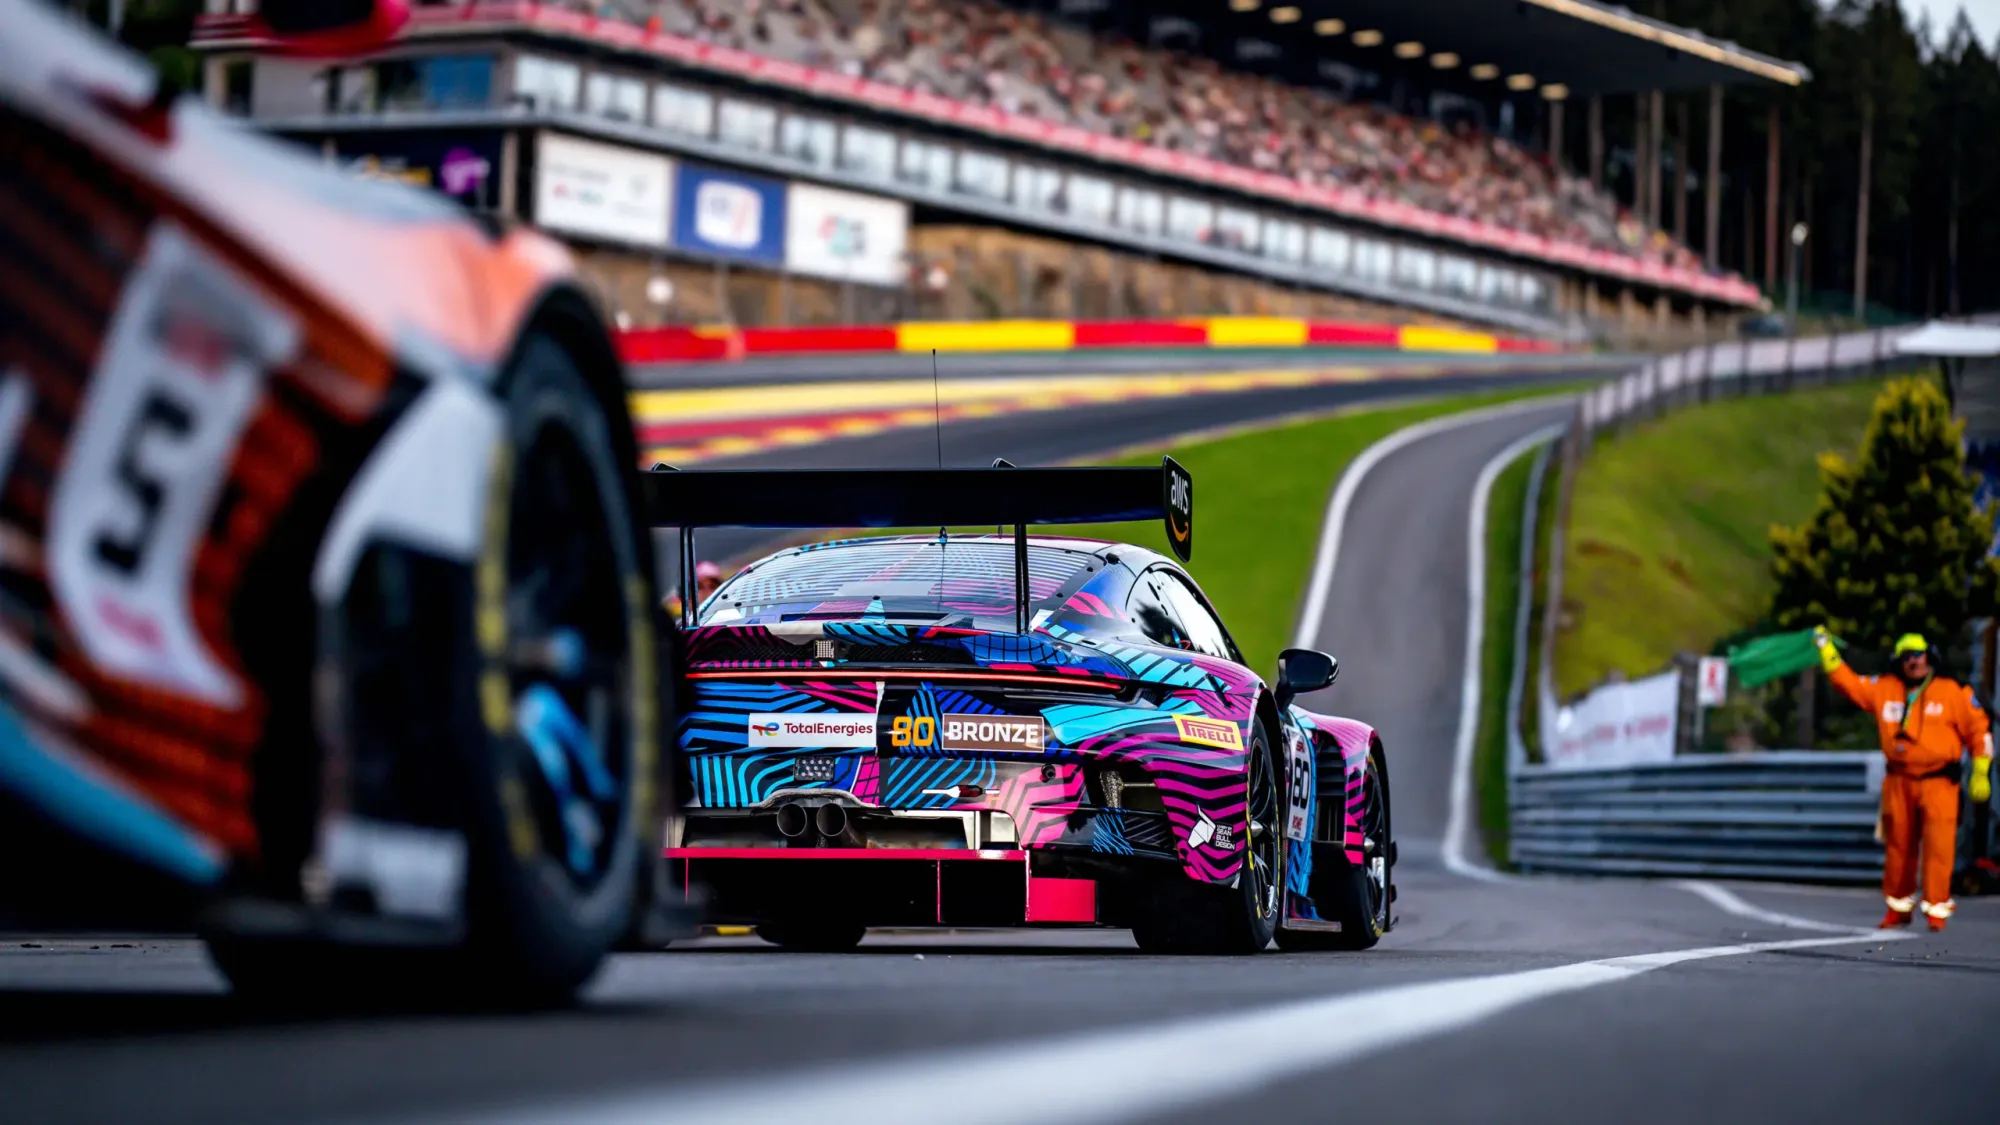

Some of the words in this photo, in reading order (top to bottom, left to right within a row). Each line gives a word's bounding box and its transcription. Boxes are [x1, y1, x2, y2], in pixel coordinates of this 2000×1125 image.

[1171, 469, 1188, 515] aws
[784, 722, 873, 737] TotalEnergies
[891, 716, 935, 747] 80
[948, 721, 1039, 744] BRONZE
[1180, 718, 1236, 744] PIRELLI
[1292, 757, 1309, 809] 80
[1216, 834, 1231, 843] BULL
